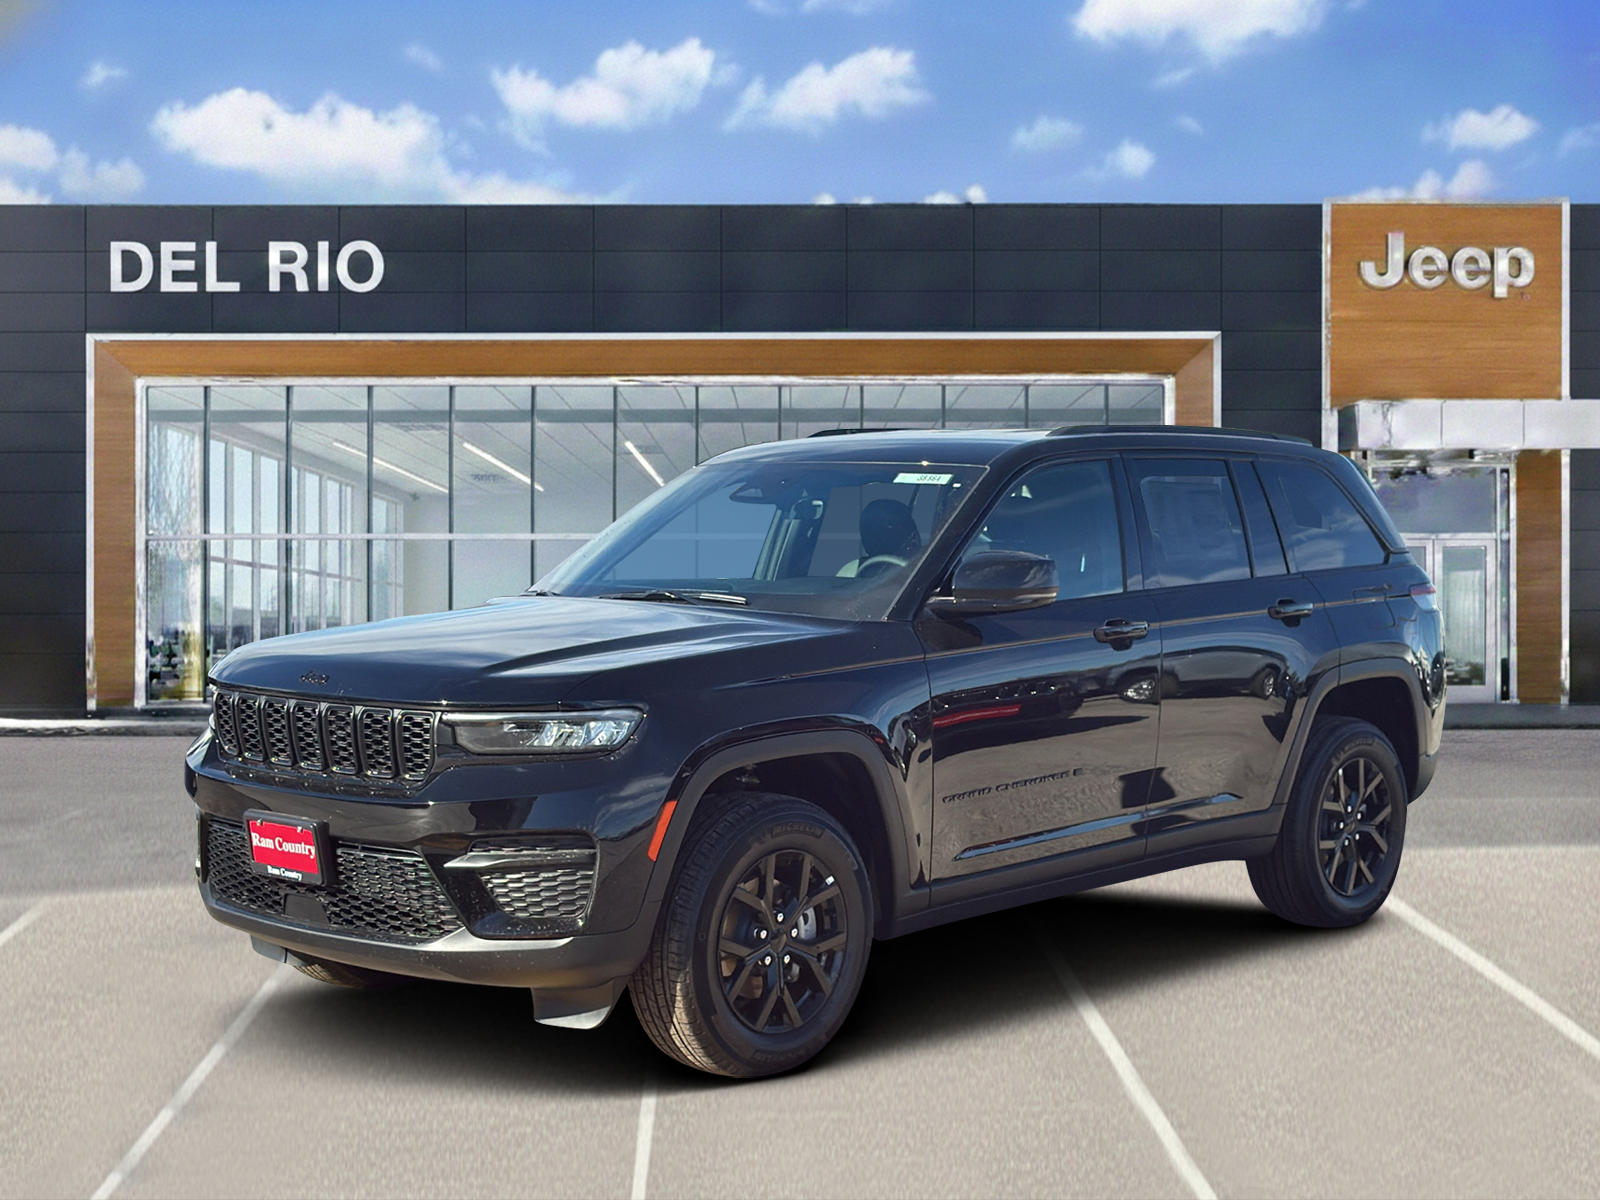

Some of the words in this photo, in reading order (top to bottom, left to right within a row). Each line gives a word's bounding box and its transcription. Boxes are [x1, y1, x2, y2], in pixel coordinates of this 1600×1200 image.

[109, 241, 241, 293] DEL
[267, 240, 384, 293] RIO
[1359, 231, 1535, 298] Jeep
[942, 786, 993, 803] GRAND
[251, 832, 274, 849] Ram
[275, 837, 316, 860] Country
